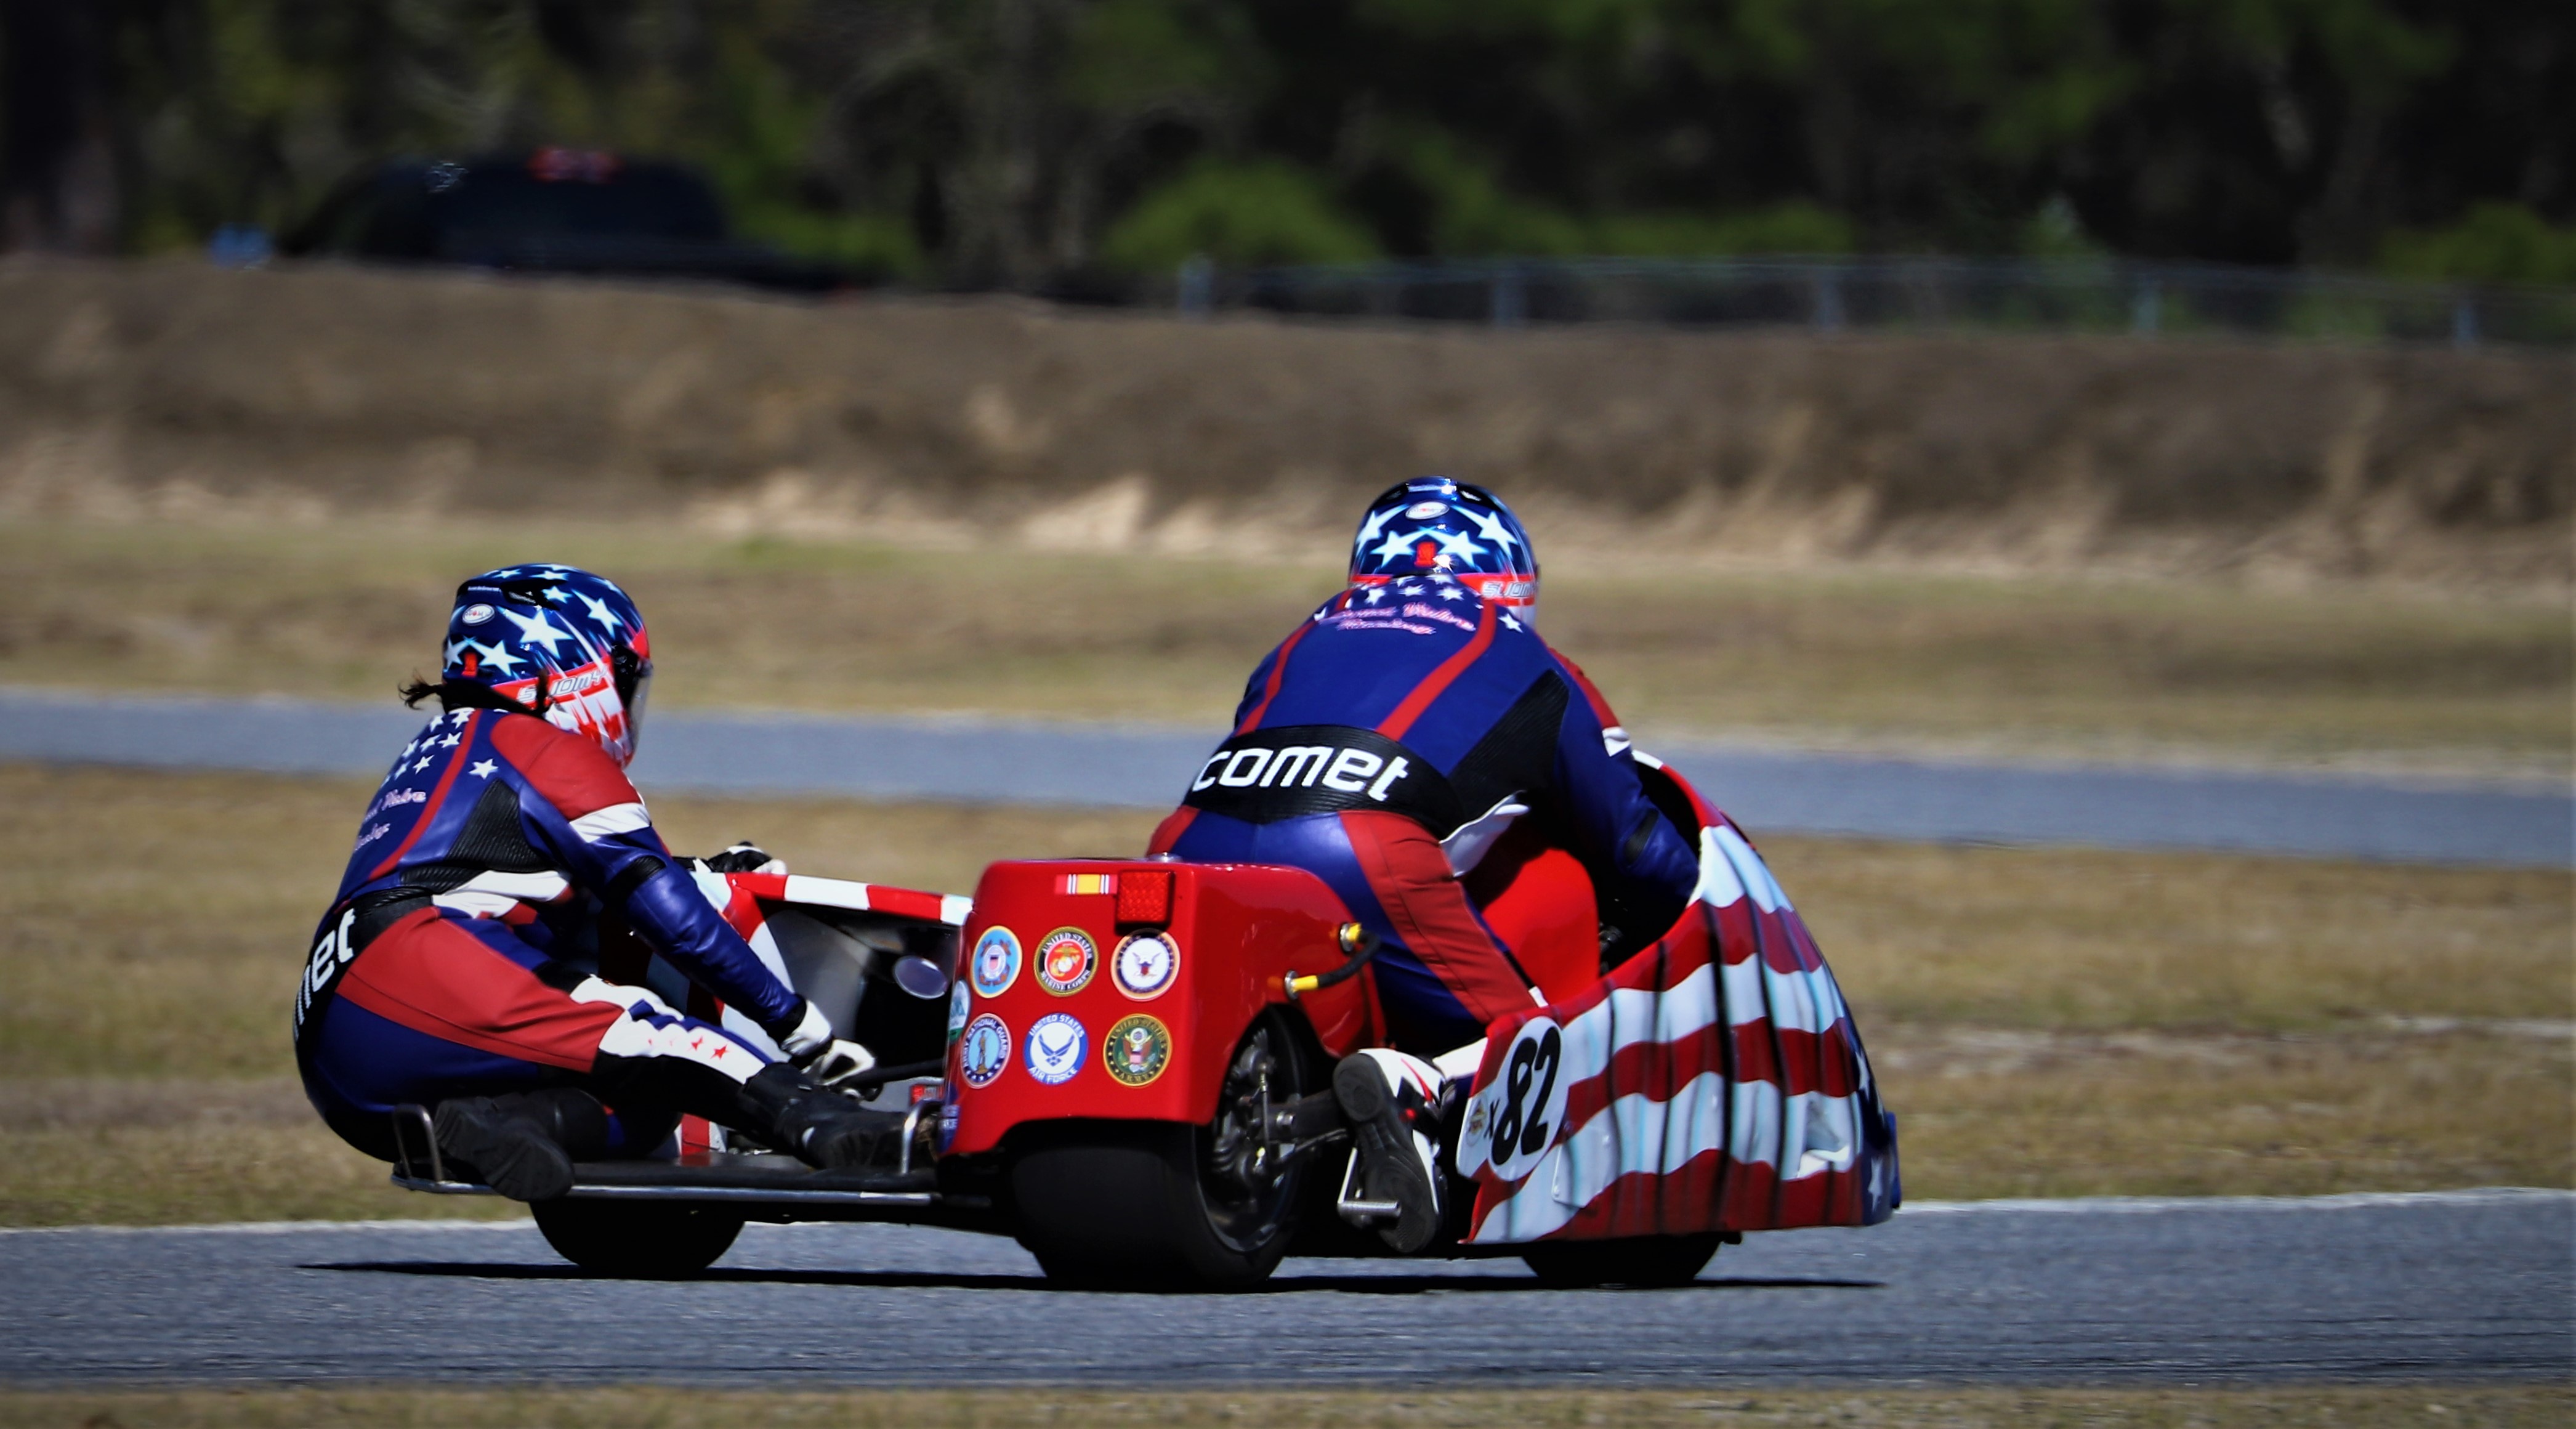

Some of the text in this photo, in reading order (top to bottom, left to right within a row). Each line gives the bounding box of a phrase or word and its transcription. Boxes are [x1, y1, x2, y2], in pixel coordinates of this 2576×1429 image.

[1192, 746, 1409, 801] comet
[1042, 932, 1072, 953] UNITED
[1072, 933, 1093, 959] STATES
[1041, 970, 1091, 990] MARINE CORPS
[1028, 1014, 1085, 1038] UNITED STATES
[1110, 1018, 1139, 1039] UNITED
[1028, 1066, 1078, 1084] AIR FORCE
[1120, 1072, 1147, 1083] ARMY
